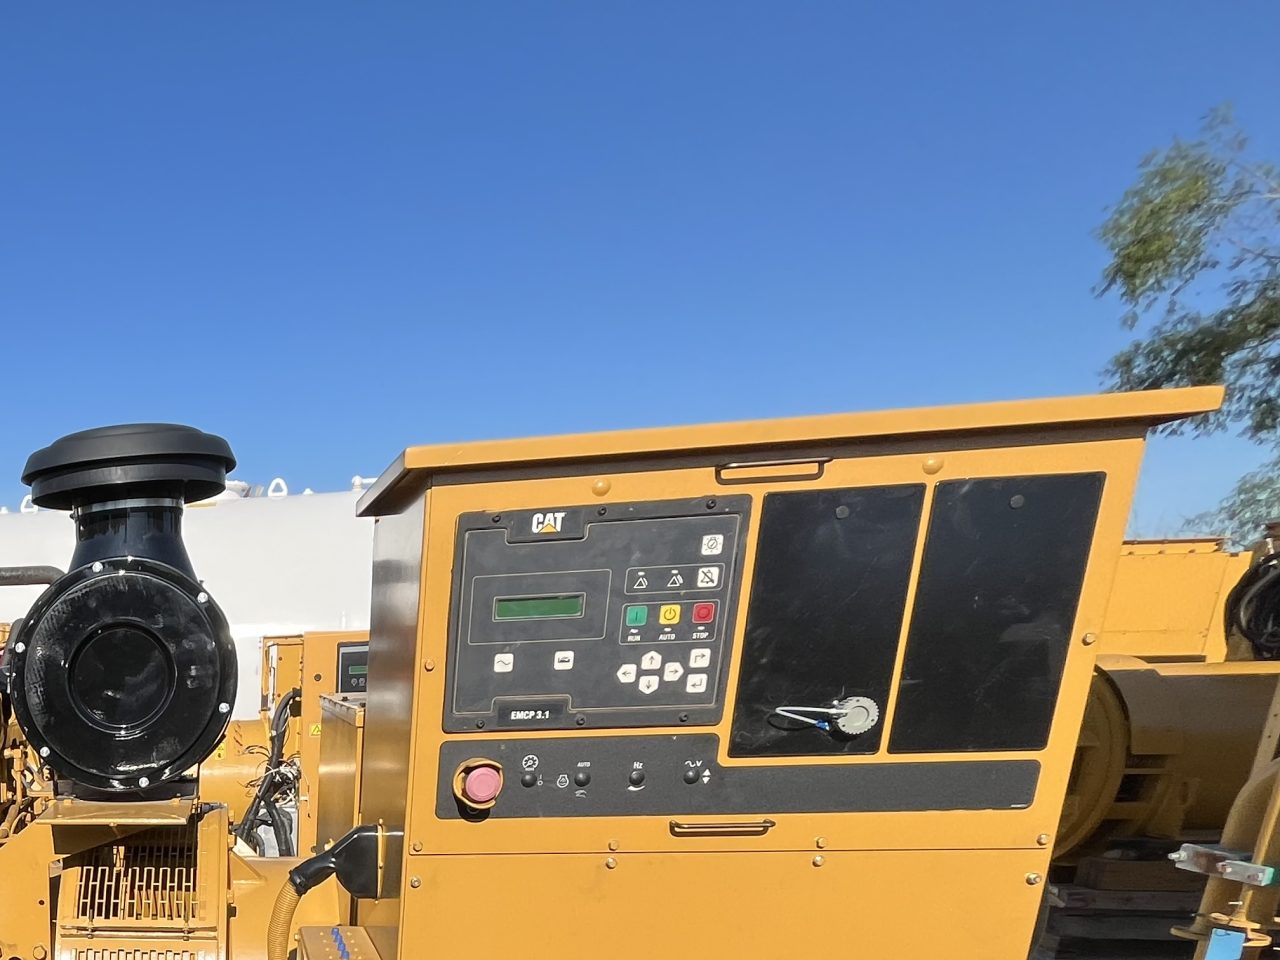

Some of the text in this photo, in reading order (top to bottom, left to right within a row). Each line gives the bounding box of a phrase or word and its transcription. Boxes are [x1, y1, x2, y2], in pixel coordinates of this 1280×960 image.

[531, 512, 567, 533] CAT
[510, 710, 550, 720] EMCP 3.1
